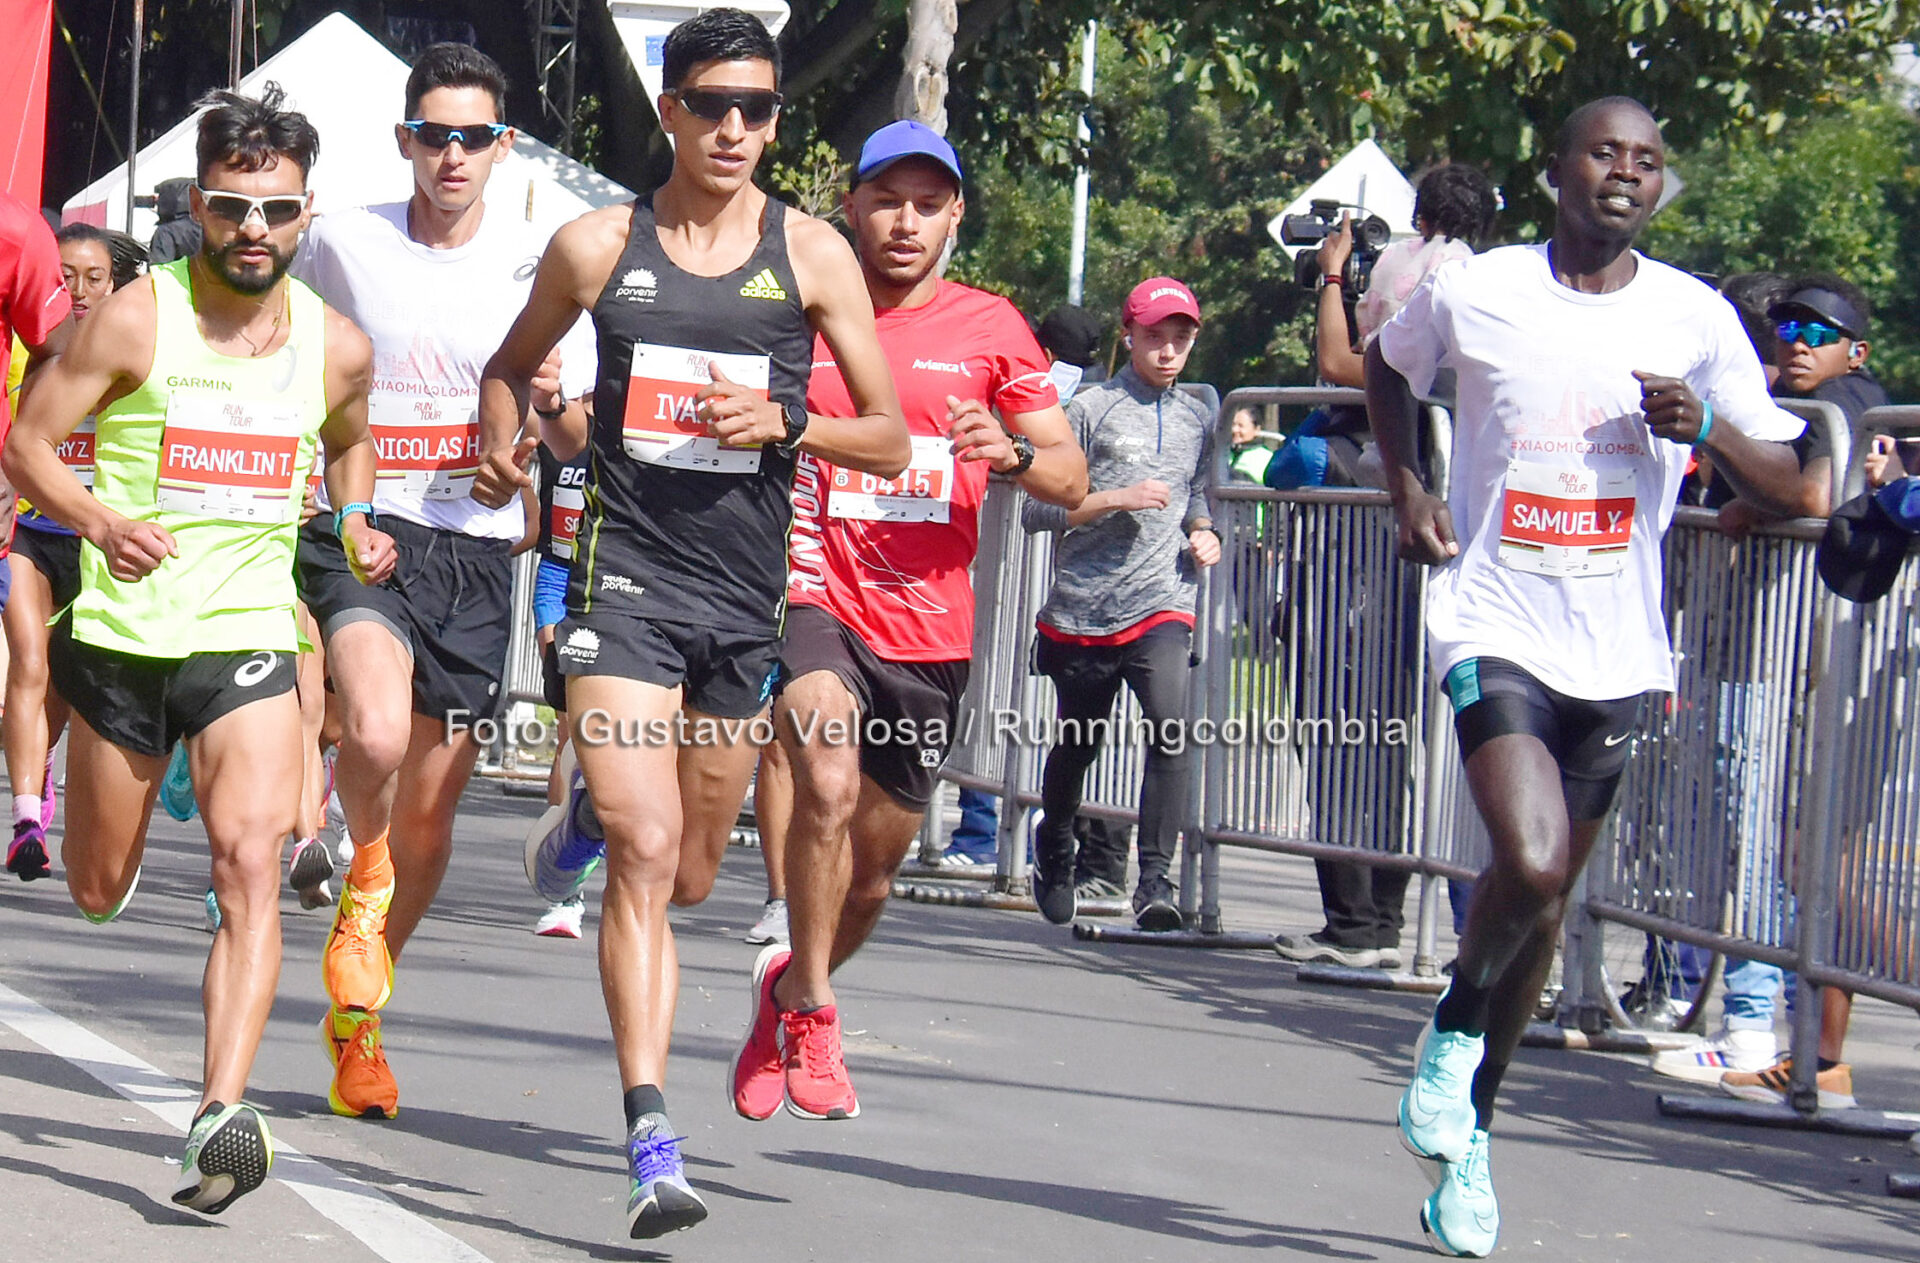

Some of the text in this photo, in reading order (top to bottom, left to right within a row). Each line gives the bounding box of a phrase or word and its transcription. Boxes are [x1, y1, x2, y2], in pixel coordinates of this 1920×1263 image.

[615, 286, 659, 298] porvenir
[739, 286, 787, 301] adidas
[686, 353, 709, 367] RUN
[912, 358, 959, 374] Avianca
[692, 366, 713, 379] TOU
[166, 376, 233, 391] GARMIN
[222, 403, 244, 416] RUN
[413, 401, 433, 412] RUN
[653, 392, 706, 424] IVA
[228, 415, 254, 428] TOUR
[420, 410, 442, 421] TOUR
[373, 436, 463, 461] NICOLAS
[690, 437, 697, 449] 7
[168, 443, 292, 477] FRANKLIN T.
[424, 472, 430, 481] 1
[1558, 472, 1579, 483] RUN
[860, 469, 931, 498] 6415
[1564, 483, 1588, 494] TOUR
[225, 487, 232, 498] 4
[1511, 503, 1624, 536] SAMUEL Y.
[1562, 548, 1569, 558] 3
[602, 574, 632, 585] equipo
[601, 581, 645, 596] porvenir
[560, 645, 599, 659] porvenir
